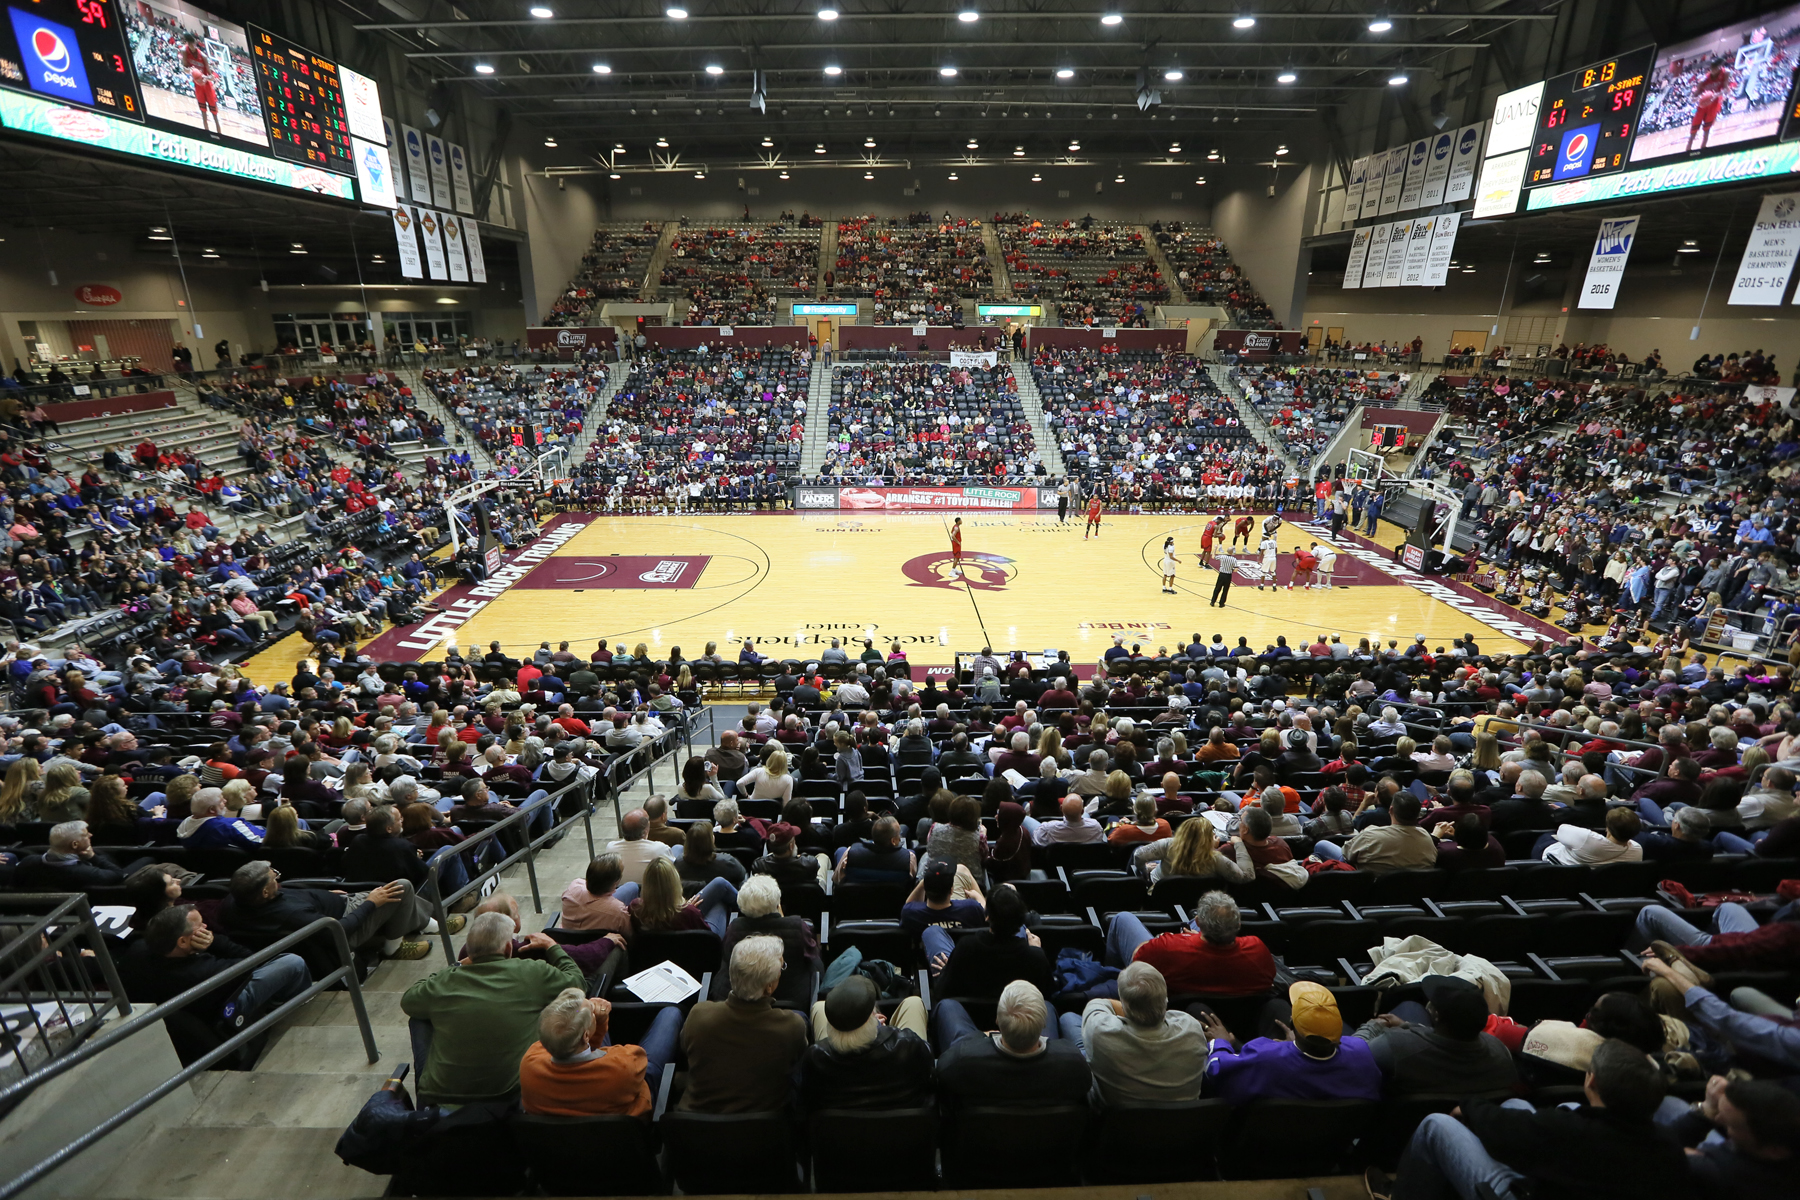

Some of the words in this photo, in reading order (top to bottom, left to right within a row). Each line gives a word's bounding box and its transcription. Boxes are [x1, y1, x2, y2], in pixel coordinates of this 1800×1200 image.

[77, 0, 107, 28] 59
[261, 33, 273, 46] LR
[113, 54, 125, 72] 3
[43, 71, 77, 88] pepsi
[1582, 62, 1616, 88] 8:13
[1607, 75, 1644, 93] A-STATE
[96, 87, 113, 98] TEAM
[123, 95, 135, 111] 8
[1553, 99, 1564, 109] LR
[1612, 89, 1634, 111] 59
[1494, 96, 1540, 125] UAMS
[1581, 105, 1590, 118] 2
[1547, 109, 1567, 128] 61
[1620, 124, 1629, 137] 3
[1461, 140, 1476, 149] NCAA
[1539, 144, 1547, 155] 2
[149, 131, 189, 162] Petit
[191, 139, 230, 170] Jean
[233, 150, 276, 182] Meats
[1435, 147, 1450, 155] NCAA
[1612, 153, 1621, 166] 8
[1562, 160, 1582, 172] pepsi
[1533, 169, 1541, 181] 8
[1612, 173, 1655, 196] Petit
[1654, 163, 1699, 190] Jean
[1700, 154, 1769, 182] Meats
[1451, 181, 1466, 192] 2012
[1426, 189, 1439, 199] 2011
[1393, 226, 1406, 235] SUN
[1415, 223, 1427, 232] SUN
[1756, 221, 1778, 231] SUN
[1391, 234, 1406, 243] BELT
[1412, 231, 1428, 240] BELT
[1434, 231, 1444, 239] SUN
[1353, 239, 1365, 248] BELT
[1763, 238, 1785, 247] MEN'S
[1748, 249, 1793, 258] BASKETBALL
[1589, 265, 1623, 273] BASKETBALL
[1747, 260, 1787, 269] CHAMPIONS
[1406, 273, 1420, 282] 2012
[1738, 277, 1785, 288] 2015-16
[1590, 284, 1611, 294] 2016
[511, 433, 524, 446] 30
[1372, 432, 1383, 446] 30
[800, 494, 835, 503] LANDERS
[965, 487, 993, 497] LITTLE
[994, 491, 1018, 501] ROCK
[885, 493, 933, 504] ARKANSAS'
[934, 496, 946, 505] #1
[946, 496, 979, 508] TOYOTA
[980, 498, 1013, 508] DEALER!
[397, 599, 488, 650] LITTLE
[470, 563, 535, 598] ROCK
[513, 522, 586, 562] TROJANS
[1345, 544, 1425, 579] ROCK
[1402, 578, 1555, 643] TROJANS
[801, 623, 879, 631] Center
[1126, 622, 1172, 630] SUN
[136, 774, 165, 783] DALLAS
